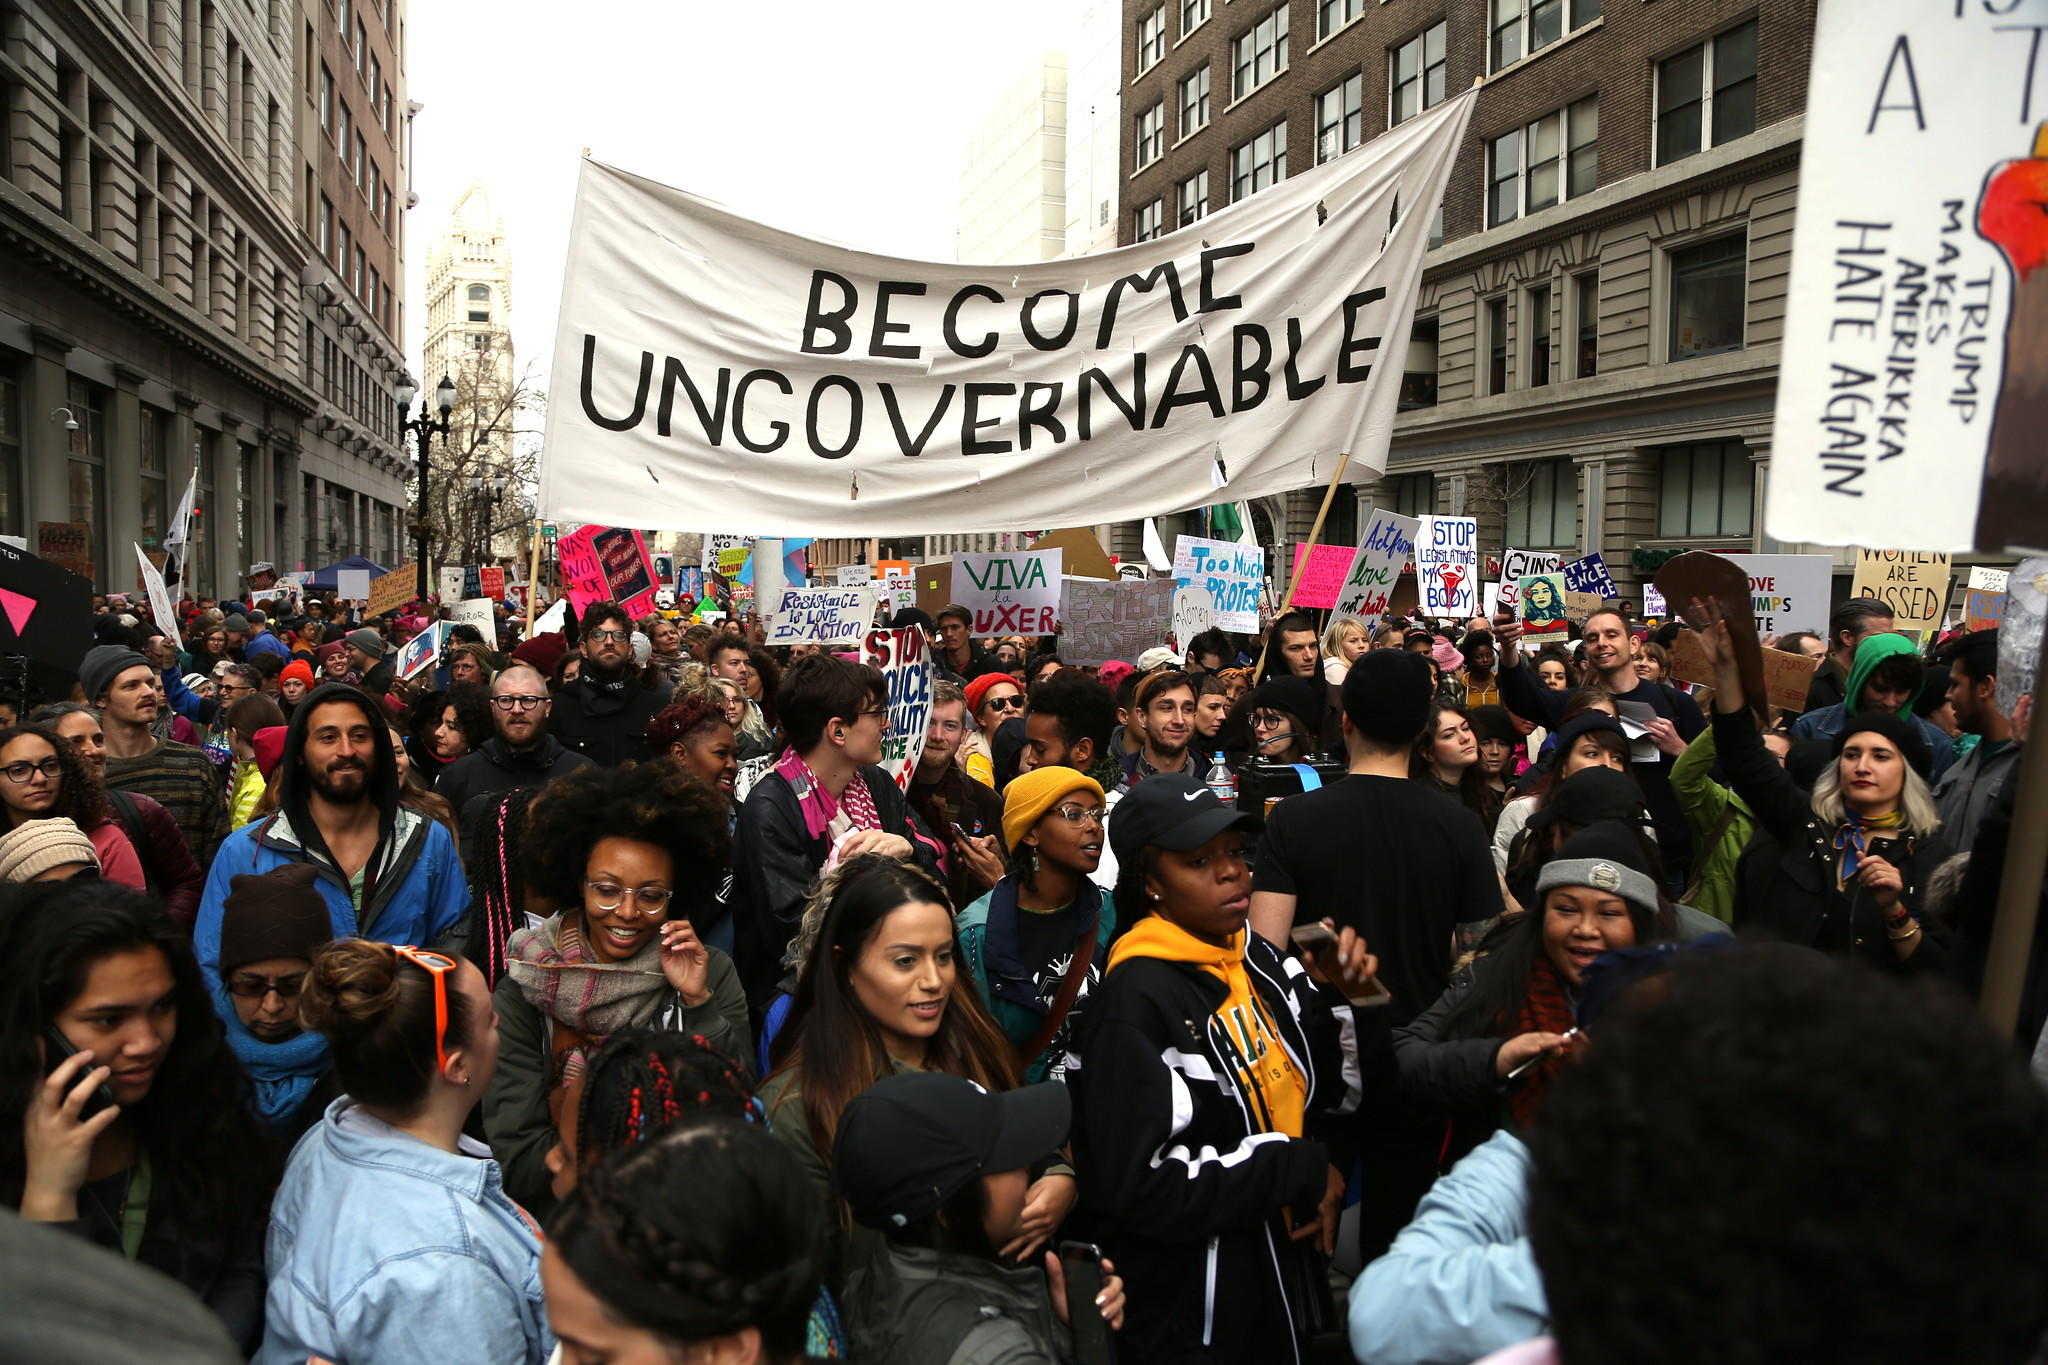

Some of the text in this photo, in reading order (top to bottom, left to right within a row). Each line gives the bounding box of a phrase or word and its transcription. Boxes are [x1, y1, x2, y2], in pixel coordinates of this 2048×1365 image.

[1926, 199, 1964, 345] MAKES
[801, 242, 1255, 359] BECOME
[1948, 266, 1995, 424] TRUMP
[1818, 220, 1893, 498] HATE AGAIN
[1877, 257, 1929, 462] AMERIKKKA
[580, 286, 1386, 459] UNGOVERNABLE
[1433, 521, 1476, 546] STOP
[610, 555, 622, 567] OUR
[1420, 549, 1476, 565] LEGISLATING
[1505, 552, 1558, 581] GUNS
[610, 557, 642, 588] OUR POWER
[962, 557, 1048, 591] VIVA
[1349, 555, 1394, 587] love
[1423, 568, 1439, 583] MY
[1567, 563, 1606, 590] ENCE
[1887, 565, 1919, 583] ARE
[897, 592, 911, 602] IS
[992, 591, 1012, 603] la
[1749, 577, 1775, 592] OVE
[1069, 581, 1177, 622] EXPECT
[1340, 593, 1364, 614] not
[1357, 590, 1387, 616] hate
[1427, 588, 1471, 608] BODY
[806, 608, 838, 624] LOVE
[974, 603, 1055, 635] UXER
[1756, 617, 1774, 632] TE
[775, 625, 806, 638] IN
